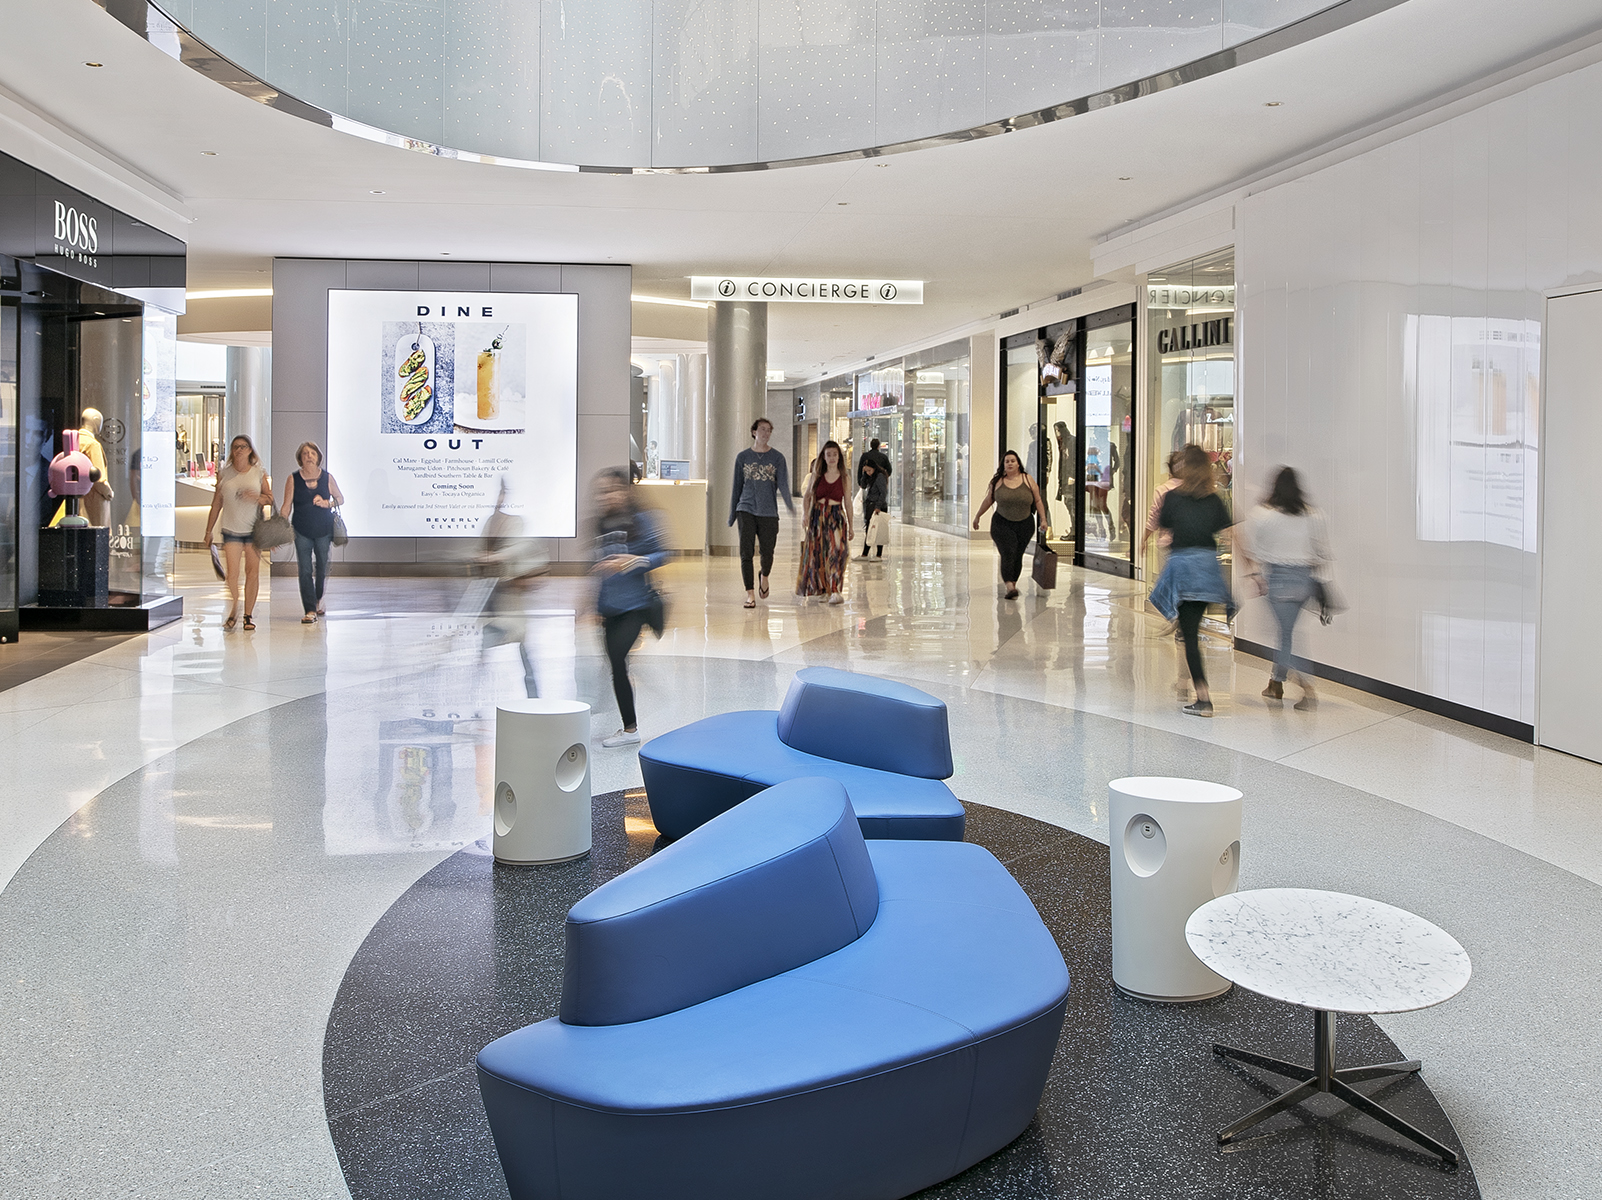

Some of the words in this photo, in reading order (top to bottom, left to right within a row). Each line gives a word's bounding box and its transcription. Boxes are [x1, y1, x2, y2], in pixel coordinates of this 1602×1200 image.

[54, 200, 98, 254] BOSS
[54, 243, 75, 260] HUGO
[78, 252, 97, 268] BOSS
[747, 281, 869, 298] CONCIERGE
[417, 305, 493, 318] DINE
[423, 438, 483, 450] OUT
[431, 482, 458, 491] Coming
[458, 482, 475, 490] Soon
